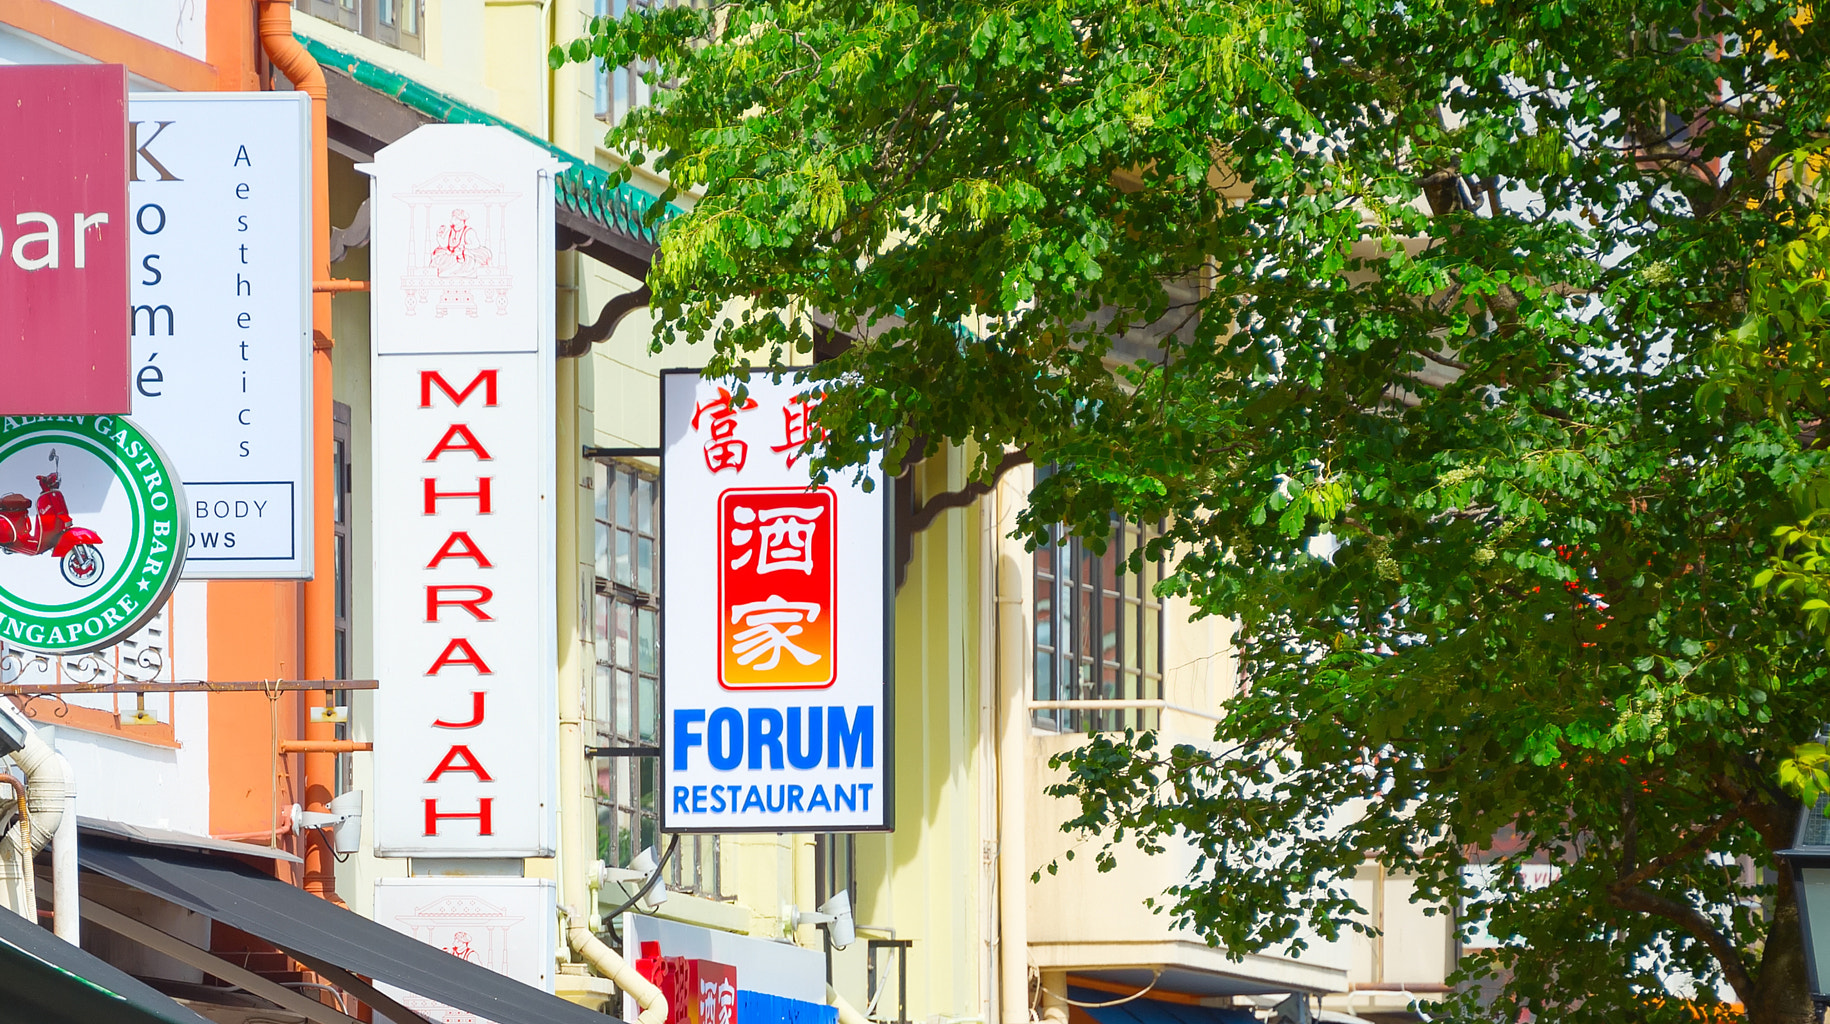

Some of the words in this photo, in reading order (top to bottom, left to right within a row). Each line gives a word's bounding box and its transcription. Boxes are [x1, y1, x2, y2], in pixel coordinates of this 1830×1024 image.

[0, 211, 109, 271] ar
[132, 121, 183, 398] Kosmé
[233, 144, 252, 458] Aesthetics
[94, 416, 169, 511] GASTRO
[142, 519, 171, 576] BAR
[196, 500, 267, 518] BODY
[420, 369, 498, 836] MAHARAJAH
[731, 505, 824, 671] 酒家
[673, 705, 874, 771] FORUM
[673, 783, 874, 814] RESTAURANT
